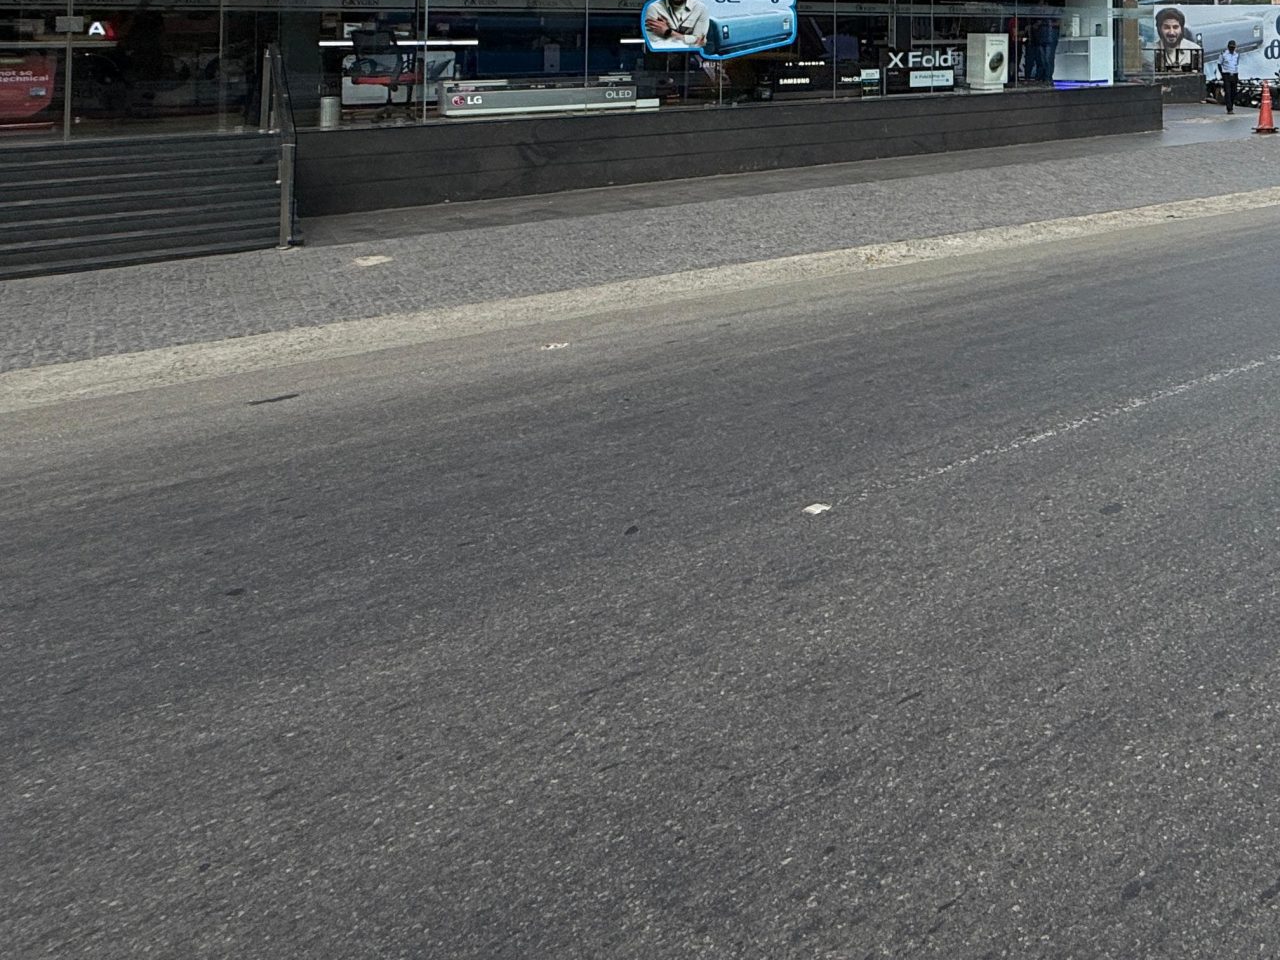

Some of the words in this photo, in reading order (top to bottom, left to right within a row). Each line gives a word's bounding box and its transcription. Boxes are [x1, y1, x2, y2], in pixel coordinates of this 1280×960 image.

[888, 51, 904, 68] X
[908, 50, 952, 67] Fold
[779, 77, 810, 85] SAMSUNG
[605, 90, 632, 99] OLED
[467, 95, 482, 105] LG
